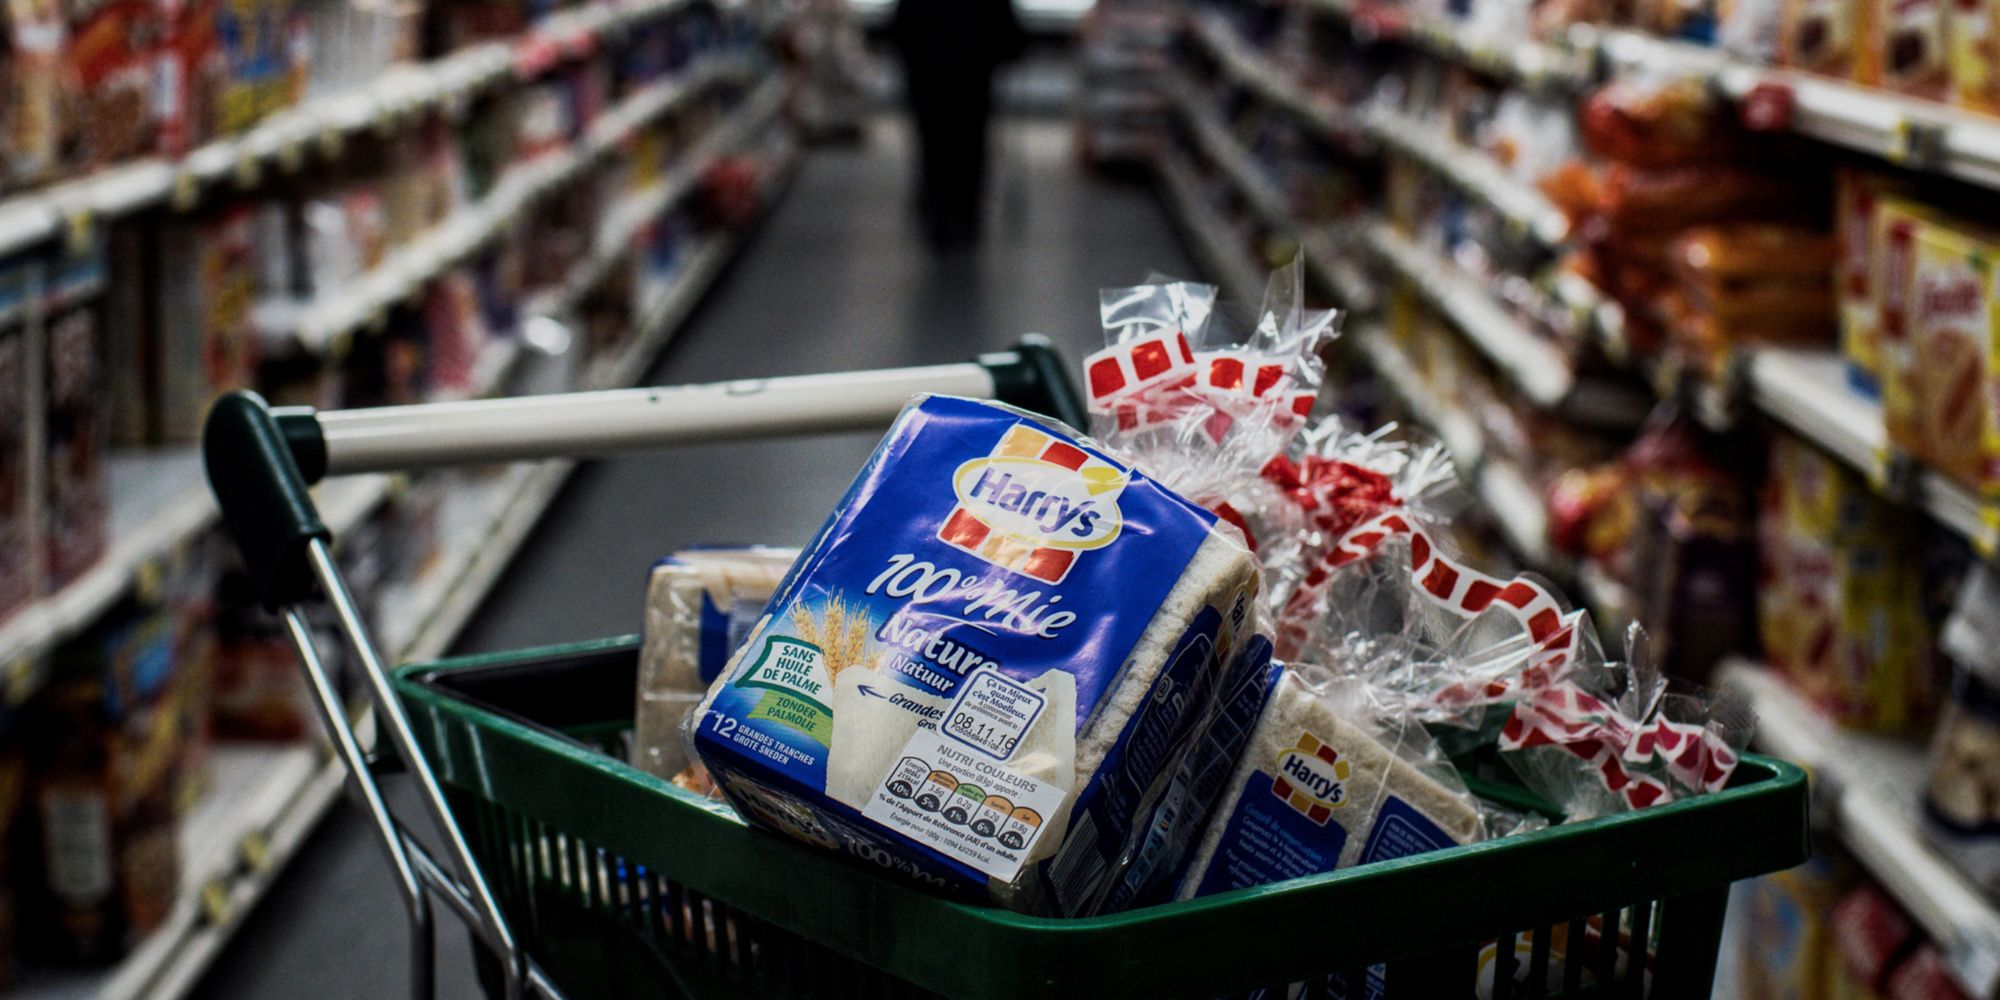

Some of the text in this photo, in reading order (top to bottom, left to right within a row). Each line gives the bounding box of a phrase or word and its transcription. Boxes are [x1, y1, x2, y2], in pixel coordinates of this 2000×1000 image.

[969, 467, 1100, 537] Harrys
[963, 578, 1077, 638] Mie
[782, 645, 816, 662] SANS
[776, 657, 813, 676] HUILE
[891, 654, 954, 692] Natuur
[763, 668, 821, 695] DE PALME
[987, 679, 1032, 704] Ça va Mieux
[776, 697, 817, 719] ZONDER
[888, 693, 945, 720] Grandes
[972, 690, 1027, 720] c'est Moelleux.
[990, 690, 1016, 705] quand
[767, 707, 817, 731] PALMOLIE
[918, 719, 937, 731] Gro
[954, 712, 1017, 750] 08.11.16
[712, 713, 814, 765] 12 GRANDES TRANCHES
[733, 733, 790, 764] GROTE SNEDEN
[937, 745, 1037, 793] NUTRI COULEURS
[938, 758, 951, 768] Une
[951, 765, 976, 781] portion
[976, 774, 993, 788] (83g)
[993, 783, 1019, 797] apporte
[1284, 755, 1342, 803] Harrys
[892, 782, 910, 797] 10%
[928, 784, 944, 798] 3.6g
[921, 797, 935, 809] 5%
[956, 797, 972, 811] 0.2g
[951, 810, 962, 822] 1%
[977, 822, 990, 834] 6%
[984, 809, 1000, 823] 6.2g
[1012, 821, 1028, 835] 0.8g
[886, 797, 895, 805] de
[895, 800, 923, 819] l'Apport
[923, 814, 932, 822] de
[980, 839, 995, 852] d'un
[996, 847, 1018, 862] adulte
[910, 823, 924, 833] pour
[926, 829, 940, 842] 100g
[944, 838, 957, 848] 1094
[1003, 833, 1021, 848] 14%
